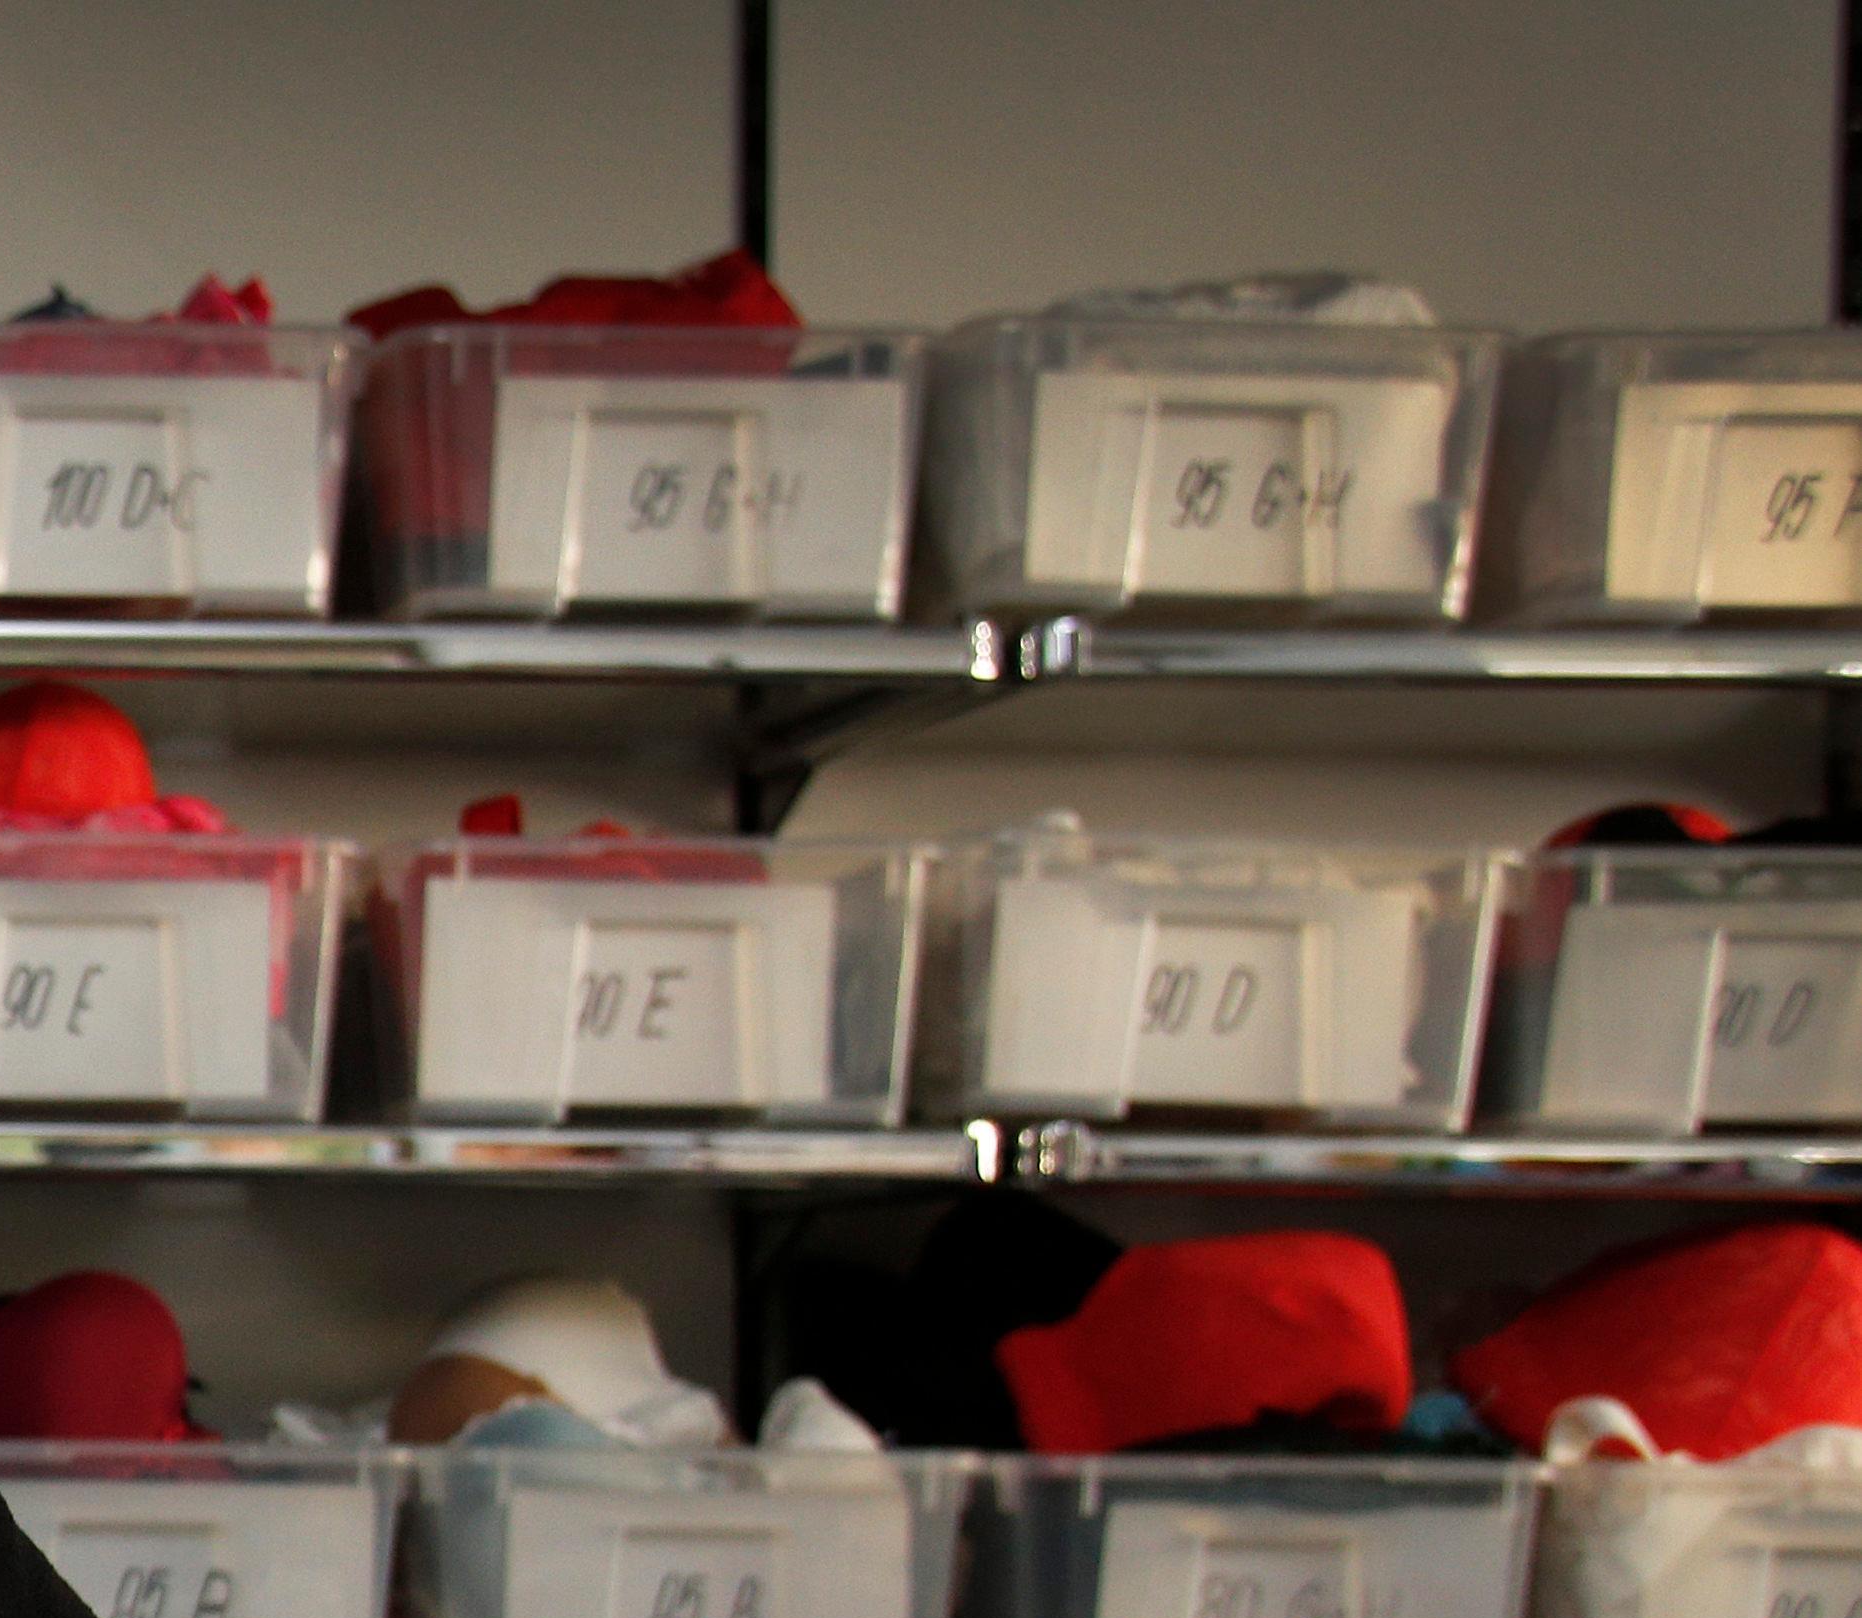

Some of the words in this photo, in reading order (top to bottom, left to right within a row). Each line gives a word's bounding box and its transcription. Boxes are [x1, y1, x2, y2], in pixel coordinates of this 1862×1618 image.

[39, 460, 108, 534] 100
[626, 456, 690, 535] 95
[1168, 456, 1232, 532] 95
[1758, 468, 1825, 546] 95
[62, 962, 110, 1040] E
[635, 964, 690, 1043] E
[1140, 963, 1202, 1038] 90
[1210, 964, 1260, 1040] D
